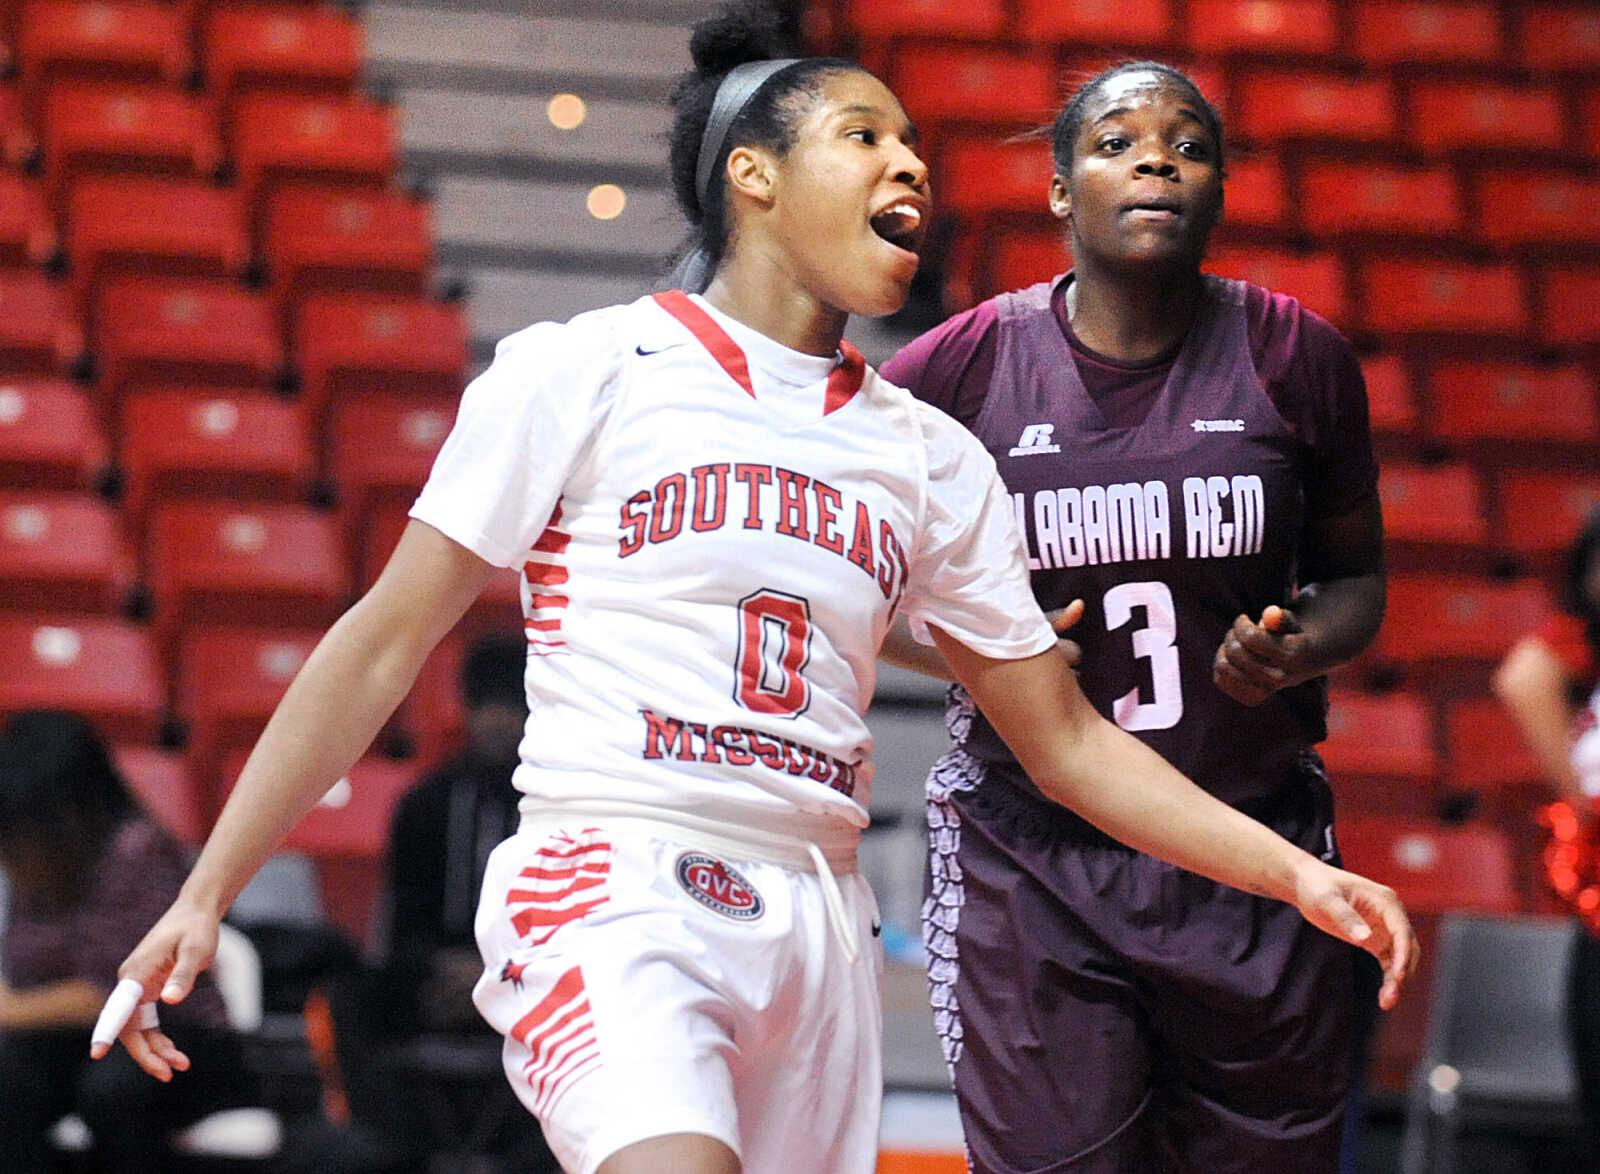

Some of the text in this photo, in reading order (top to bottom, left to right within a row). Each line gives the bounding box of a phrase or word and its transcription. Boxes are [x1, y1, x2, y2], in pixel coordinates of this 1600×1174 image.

[1007, 475, 1265, 571] LABAMA A&M
[733, 587, 813, 720] 0
[1103, 581, 1184, 731] 3
[696, 868, 742, 904] OVC
